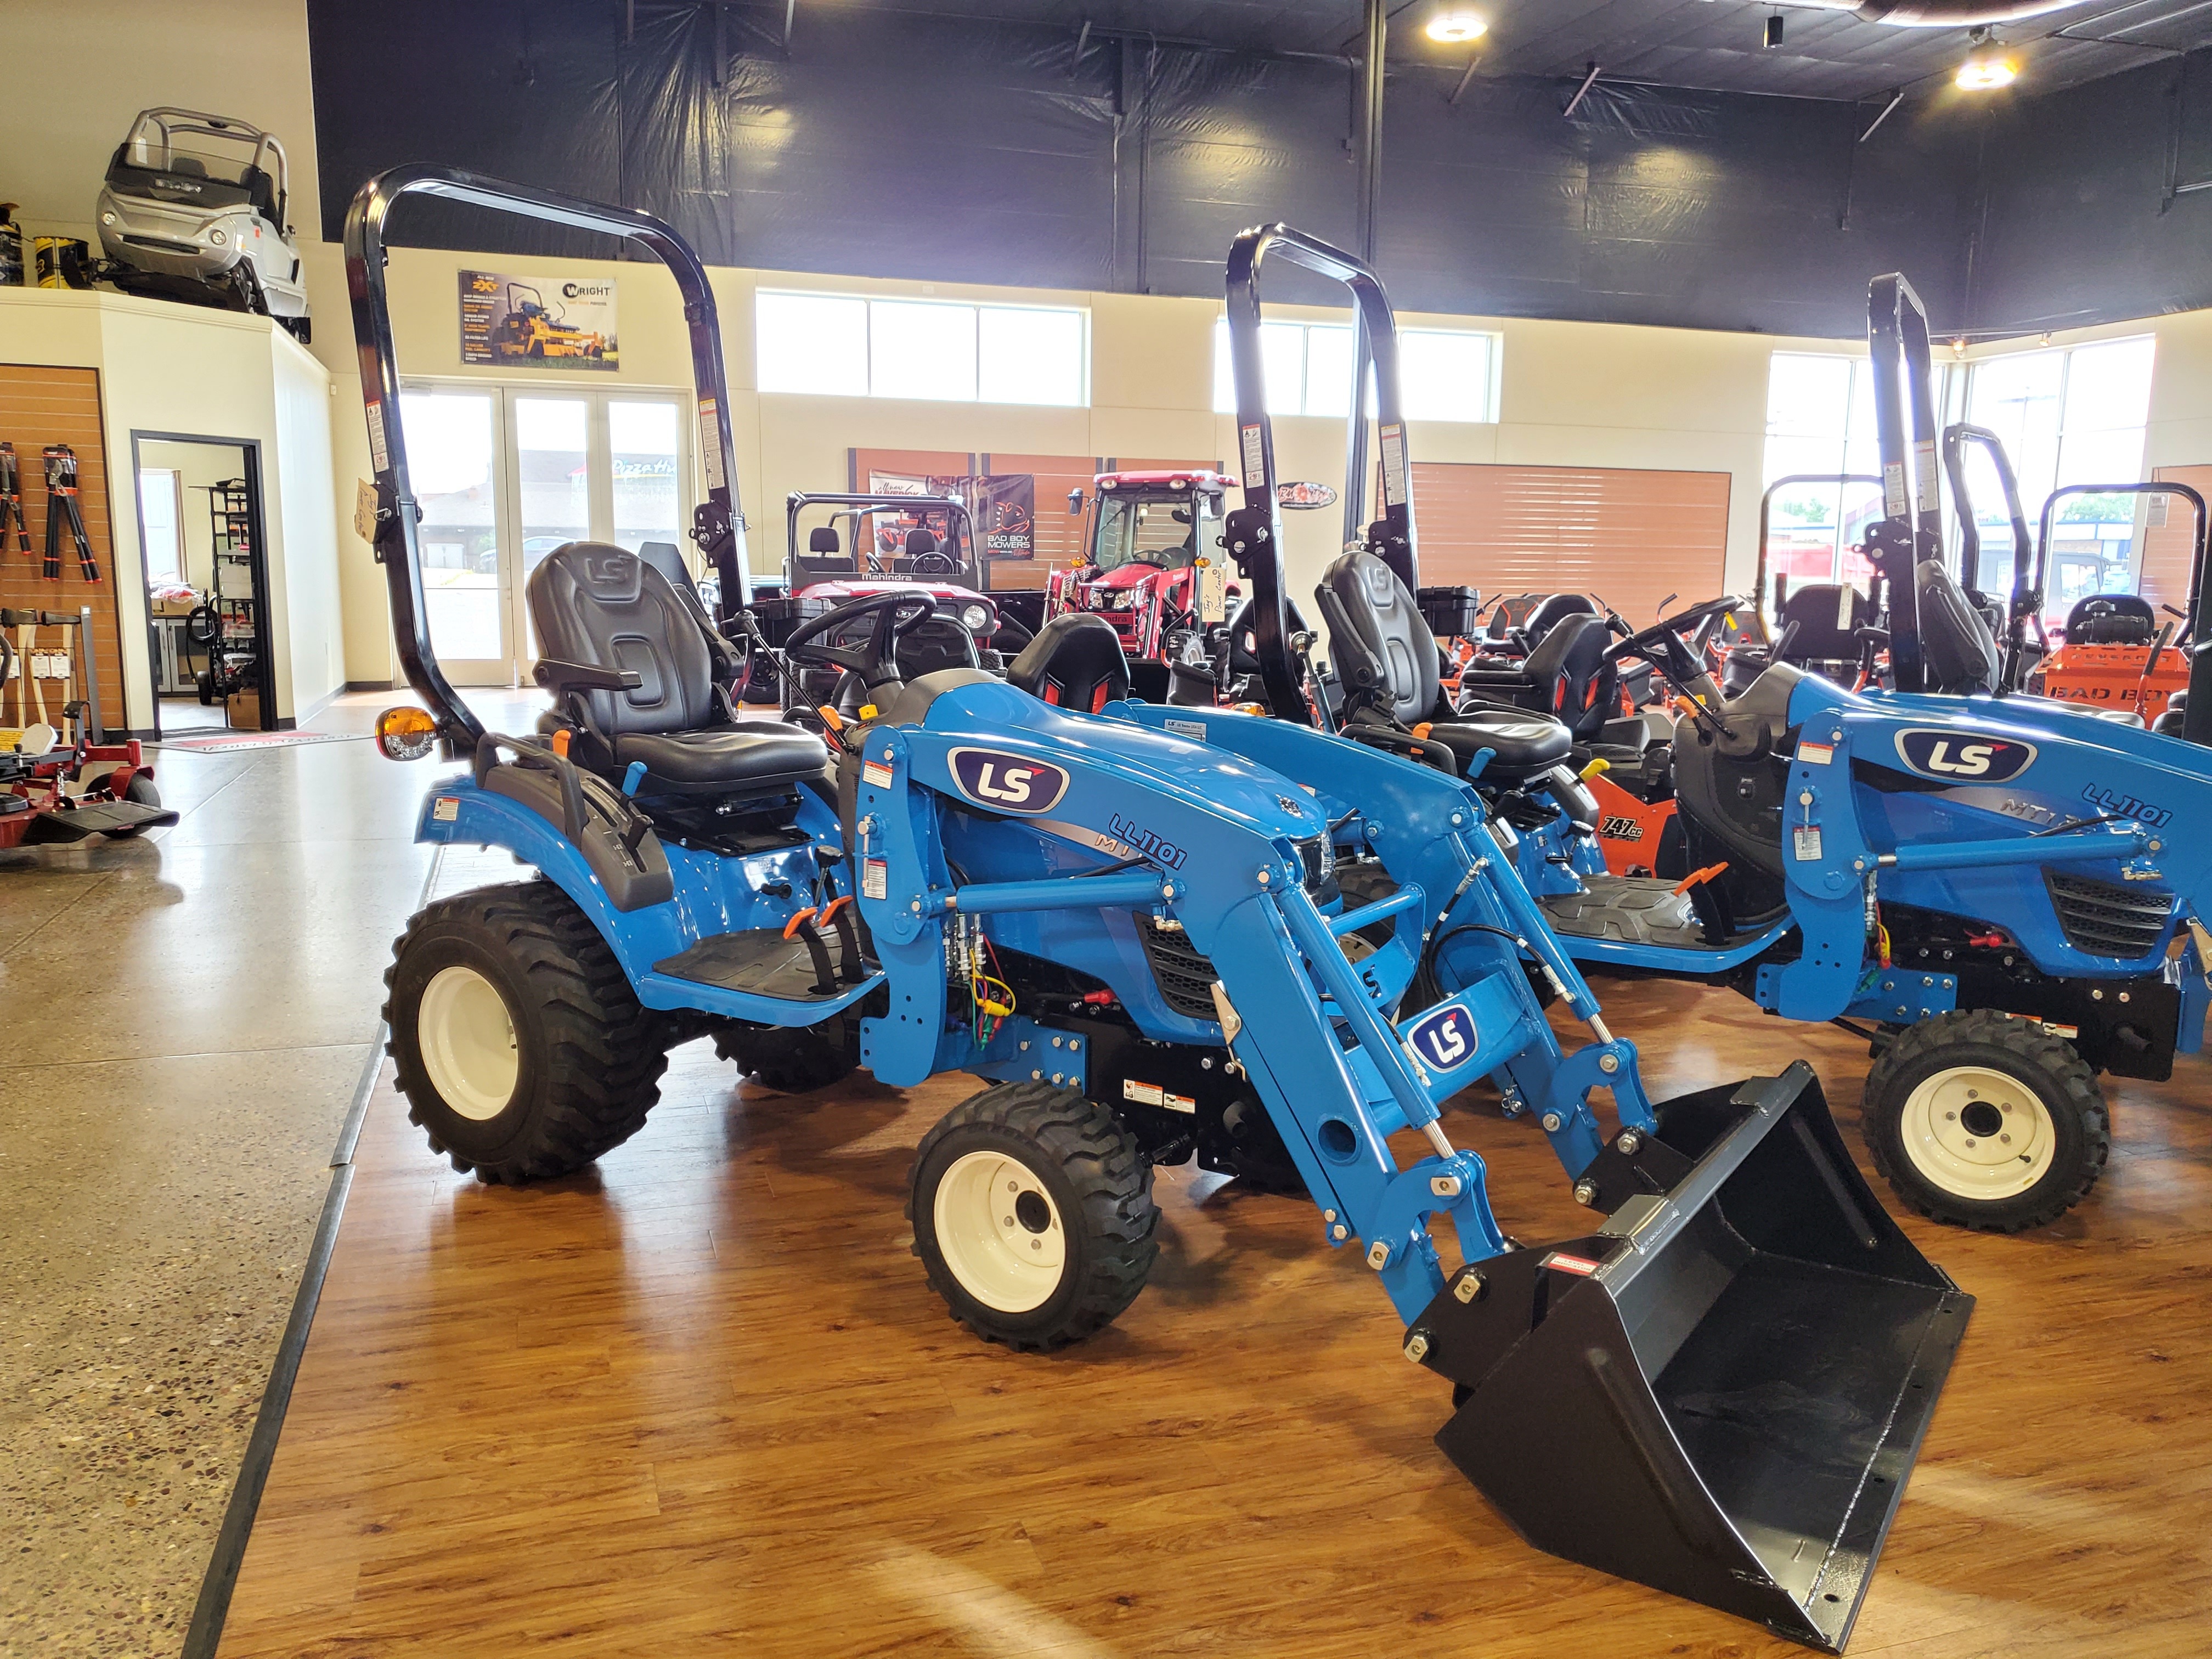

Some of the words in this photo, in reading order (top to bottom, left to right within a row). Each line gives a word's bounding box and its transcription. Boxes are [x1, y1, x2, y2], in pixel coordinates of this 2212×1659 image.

[565, 285, 611, 297] WRIGHT
[613, 459, 652, 475] Pizza
[653, 459, 677, 474] Hu
[1104, 614, 1127, 623] indra
[2049, 686, 2111, 699] BAD
[1928, 741, 1993, 775] LS
[978, 762, 1032, 803] LS
[2081, 783, 2173, 828] LL1101
[1108, 812, 1188, 871] LL1101
[1362, 969, 1382, 1000] S
[1429, 1019, 1465, 1063] LS
[1554, 1260, 1591, 1271] INDICATOR
